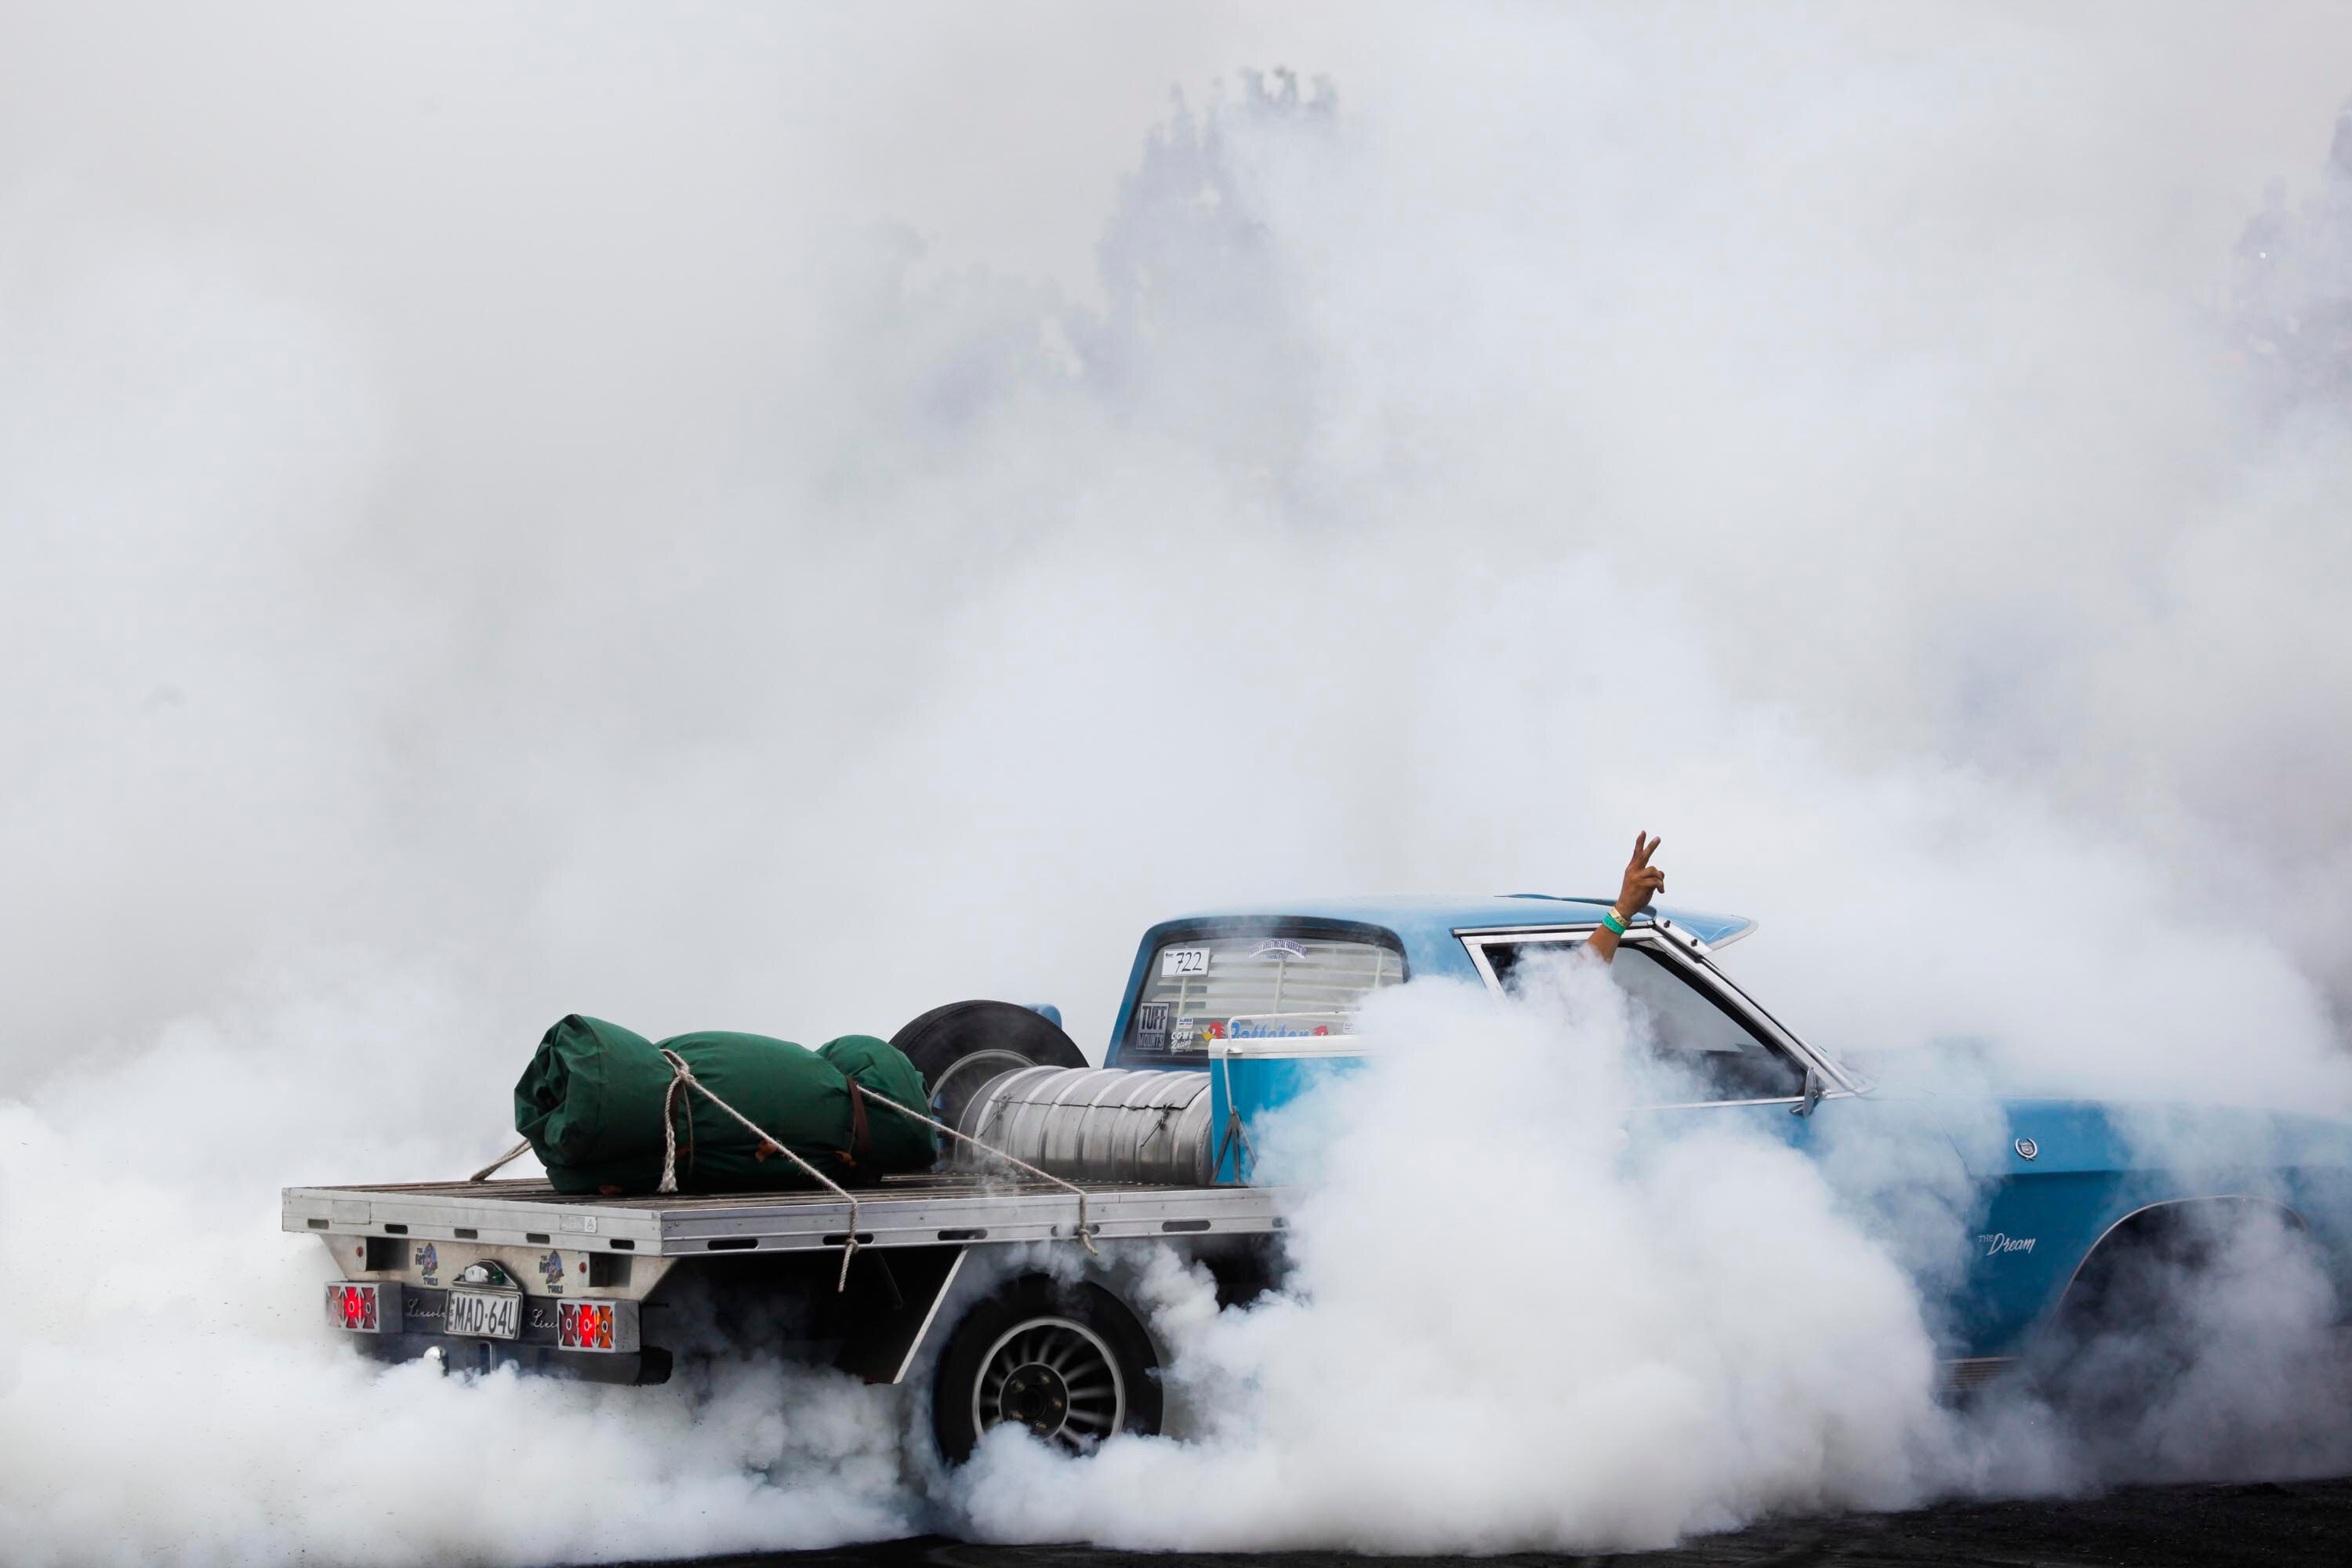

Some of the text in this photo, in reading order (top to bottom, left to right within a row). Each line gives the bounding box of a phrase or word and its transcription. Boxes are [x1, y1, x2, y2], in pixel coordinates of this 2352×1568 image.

[1175, 951, 1203, 974] 722
[1142, 1005, 1167, 1030] TUFF
[1137, 1033, 1163, 1048] MOUNTS
[1171, 1039, 1192, 1050] Racing
[1986, 1232, 2036, 1256] Dream
